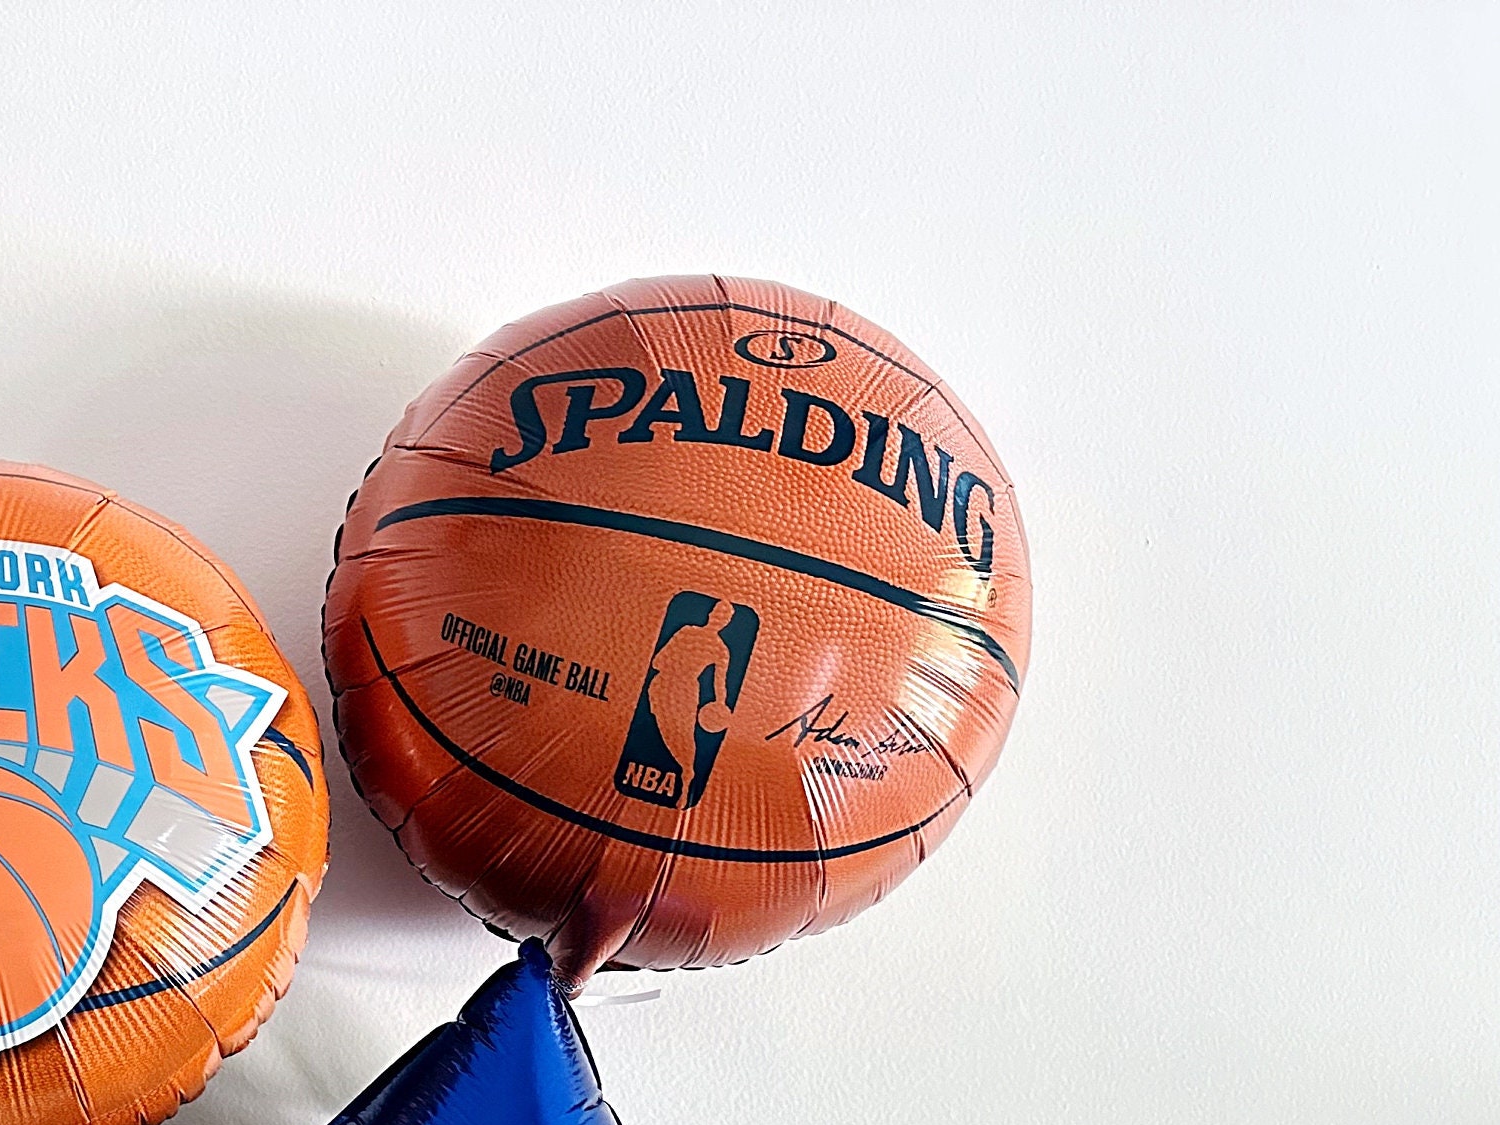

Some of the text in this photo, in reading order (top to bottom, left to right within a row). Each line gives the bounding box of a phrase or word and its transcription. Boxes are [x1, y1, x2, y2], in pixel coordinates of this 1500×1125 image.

[489, 366, 996, 585] SPALDING
[440, 612, 611, 703] OFFICIAL GAME BALL
[489, 671, 532, 707] @NBA
[622, 761, 676, 798] NBA
